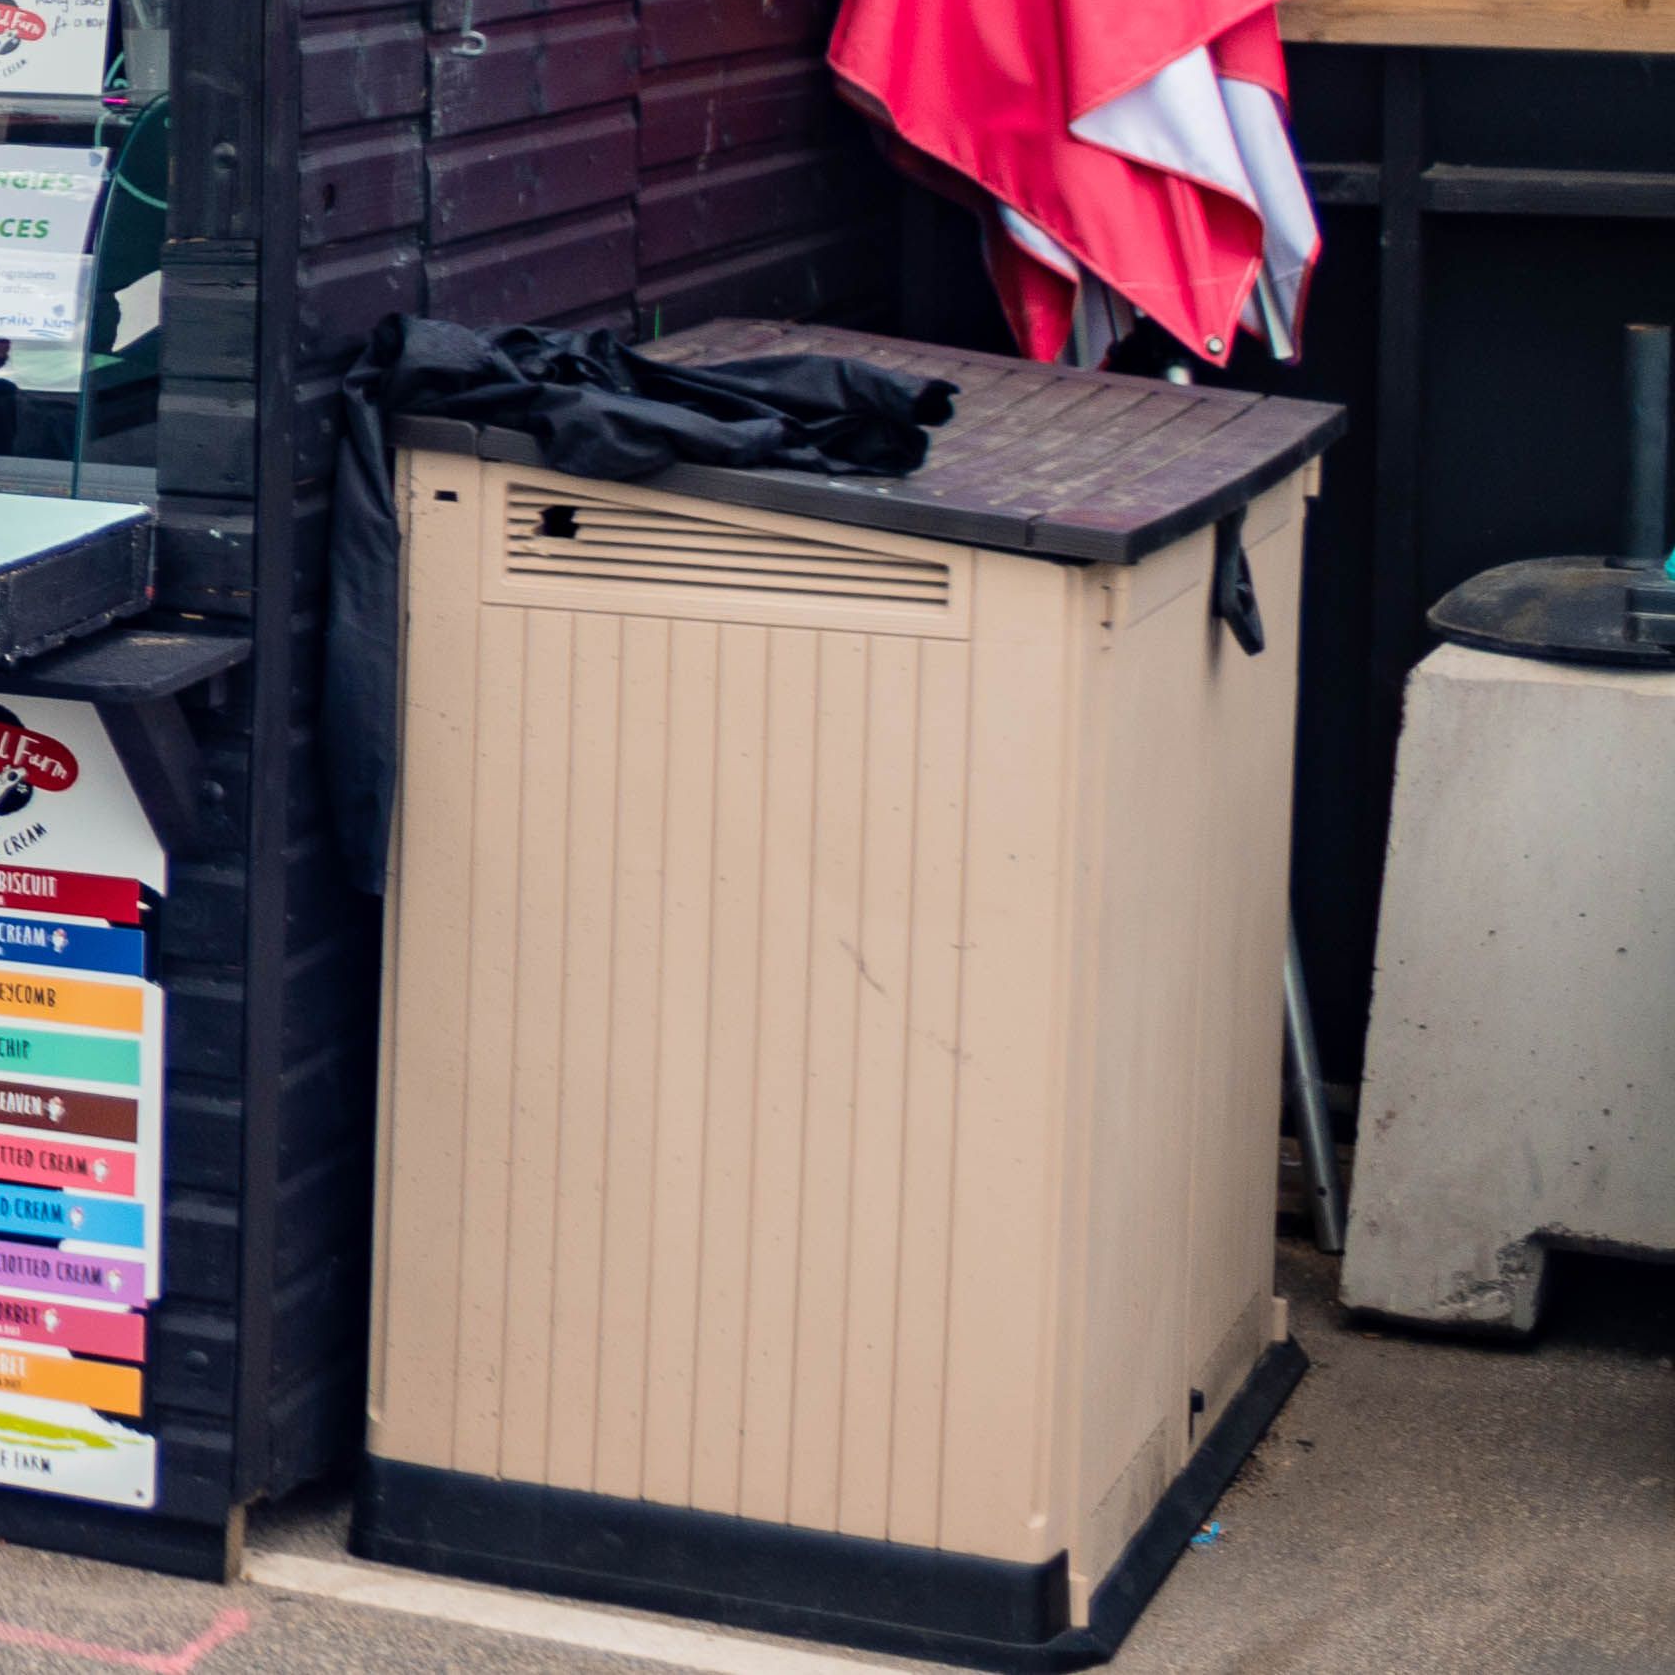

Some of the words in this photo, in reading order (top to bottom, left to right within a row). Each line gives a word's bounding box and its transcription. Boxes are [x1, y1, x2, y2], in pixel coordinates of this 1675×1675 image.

[13, 734, 68, 779] Farm
[4, 822, 47, 855] CREAM
[39, 1150, 89, 1176] CREAM
[15, 1198, 65, 1224] CREAM
[56, 1263, 104, 1287] CREAM
[14, 1451, 52, 1473] FARM
